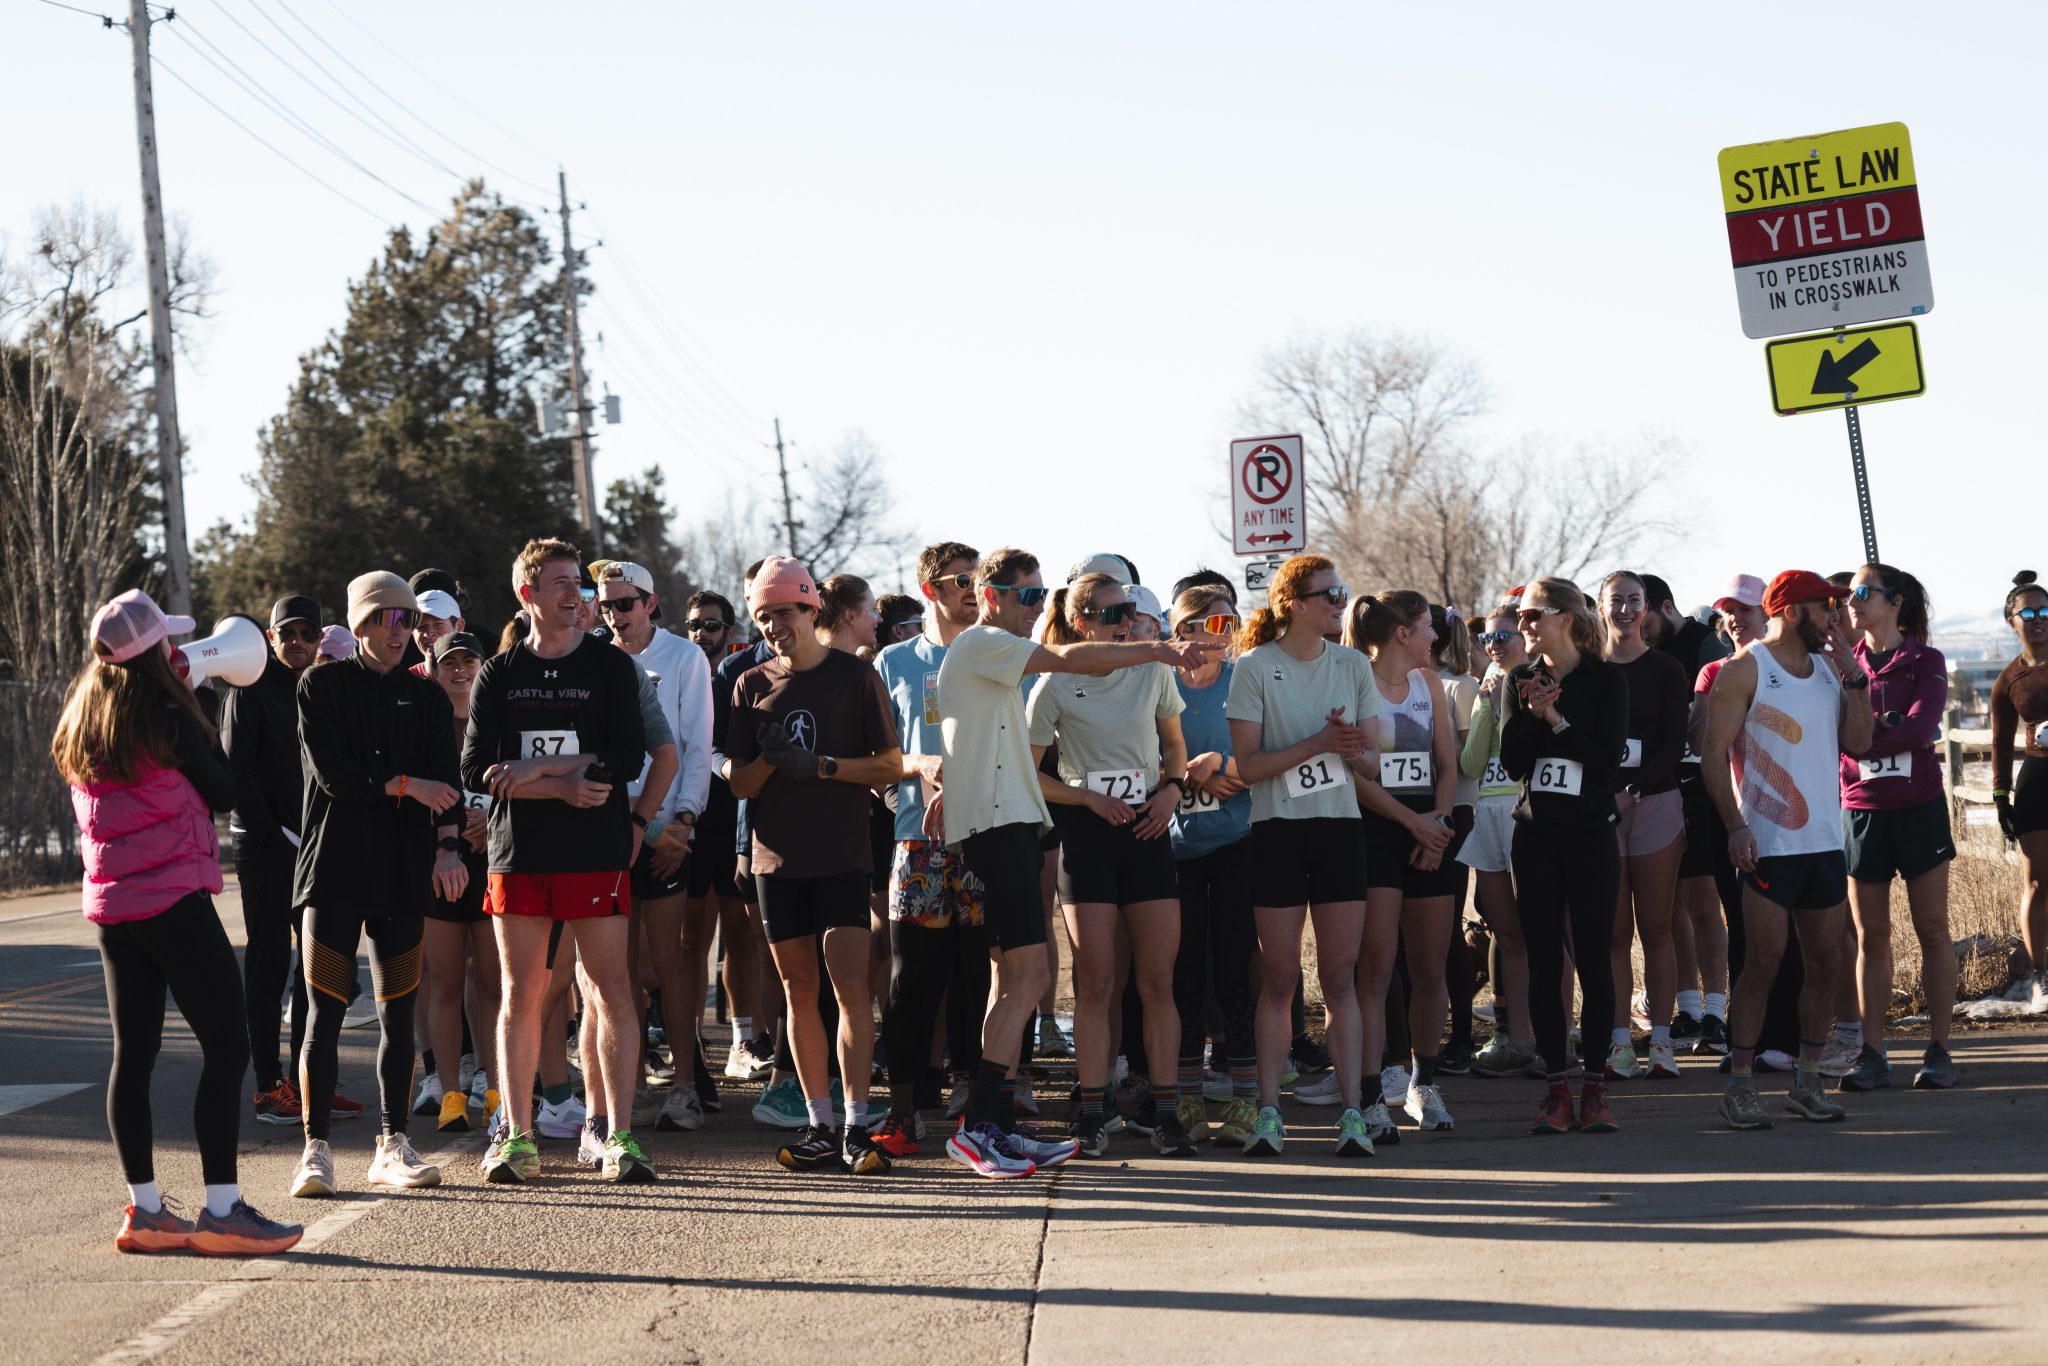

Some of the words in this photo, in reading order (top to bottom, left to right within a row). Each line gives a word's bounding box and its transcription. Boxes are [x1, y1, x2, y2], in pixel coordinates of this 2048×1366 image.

[1734, 159, 1825, 204] STATE
[1835, 147, 1899, 189] LAW
[1758, 202, 1891, 251] YIELD
[1756, 270, 1778, 289] TO
[1786, 250, 1907, 285] PEDESTRIANS
[1769, 292, 1787, 310] IN
[1795, 274, 1900, 306] CROSSWALK
[1243, 509, 1265, 527] ANY
[1270, 507, 1294, 525] TIME
[507, 688, 554, 700] CASTLE
[558, 688, 591, 700] VIEW
[532, 736, 565, 758] 87
[1298, 760, 1334, 789] 81
[1392, 757, 1422, 782] 75
[1485, 762, 1507, 783] 58
[1540, 763, 1568, 788] 61
[1100, 775, 1135, 800] 72
[1181, 785, 1214, 809] 90
